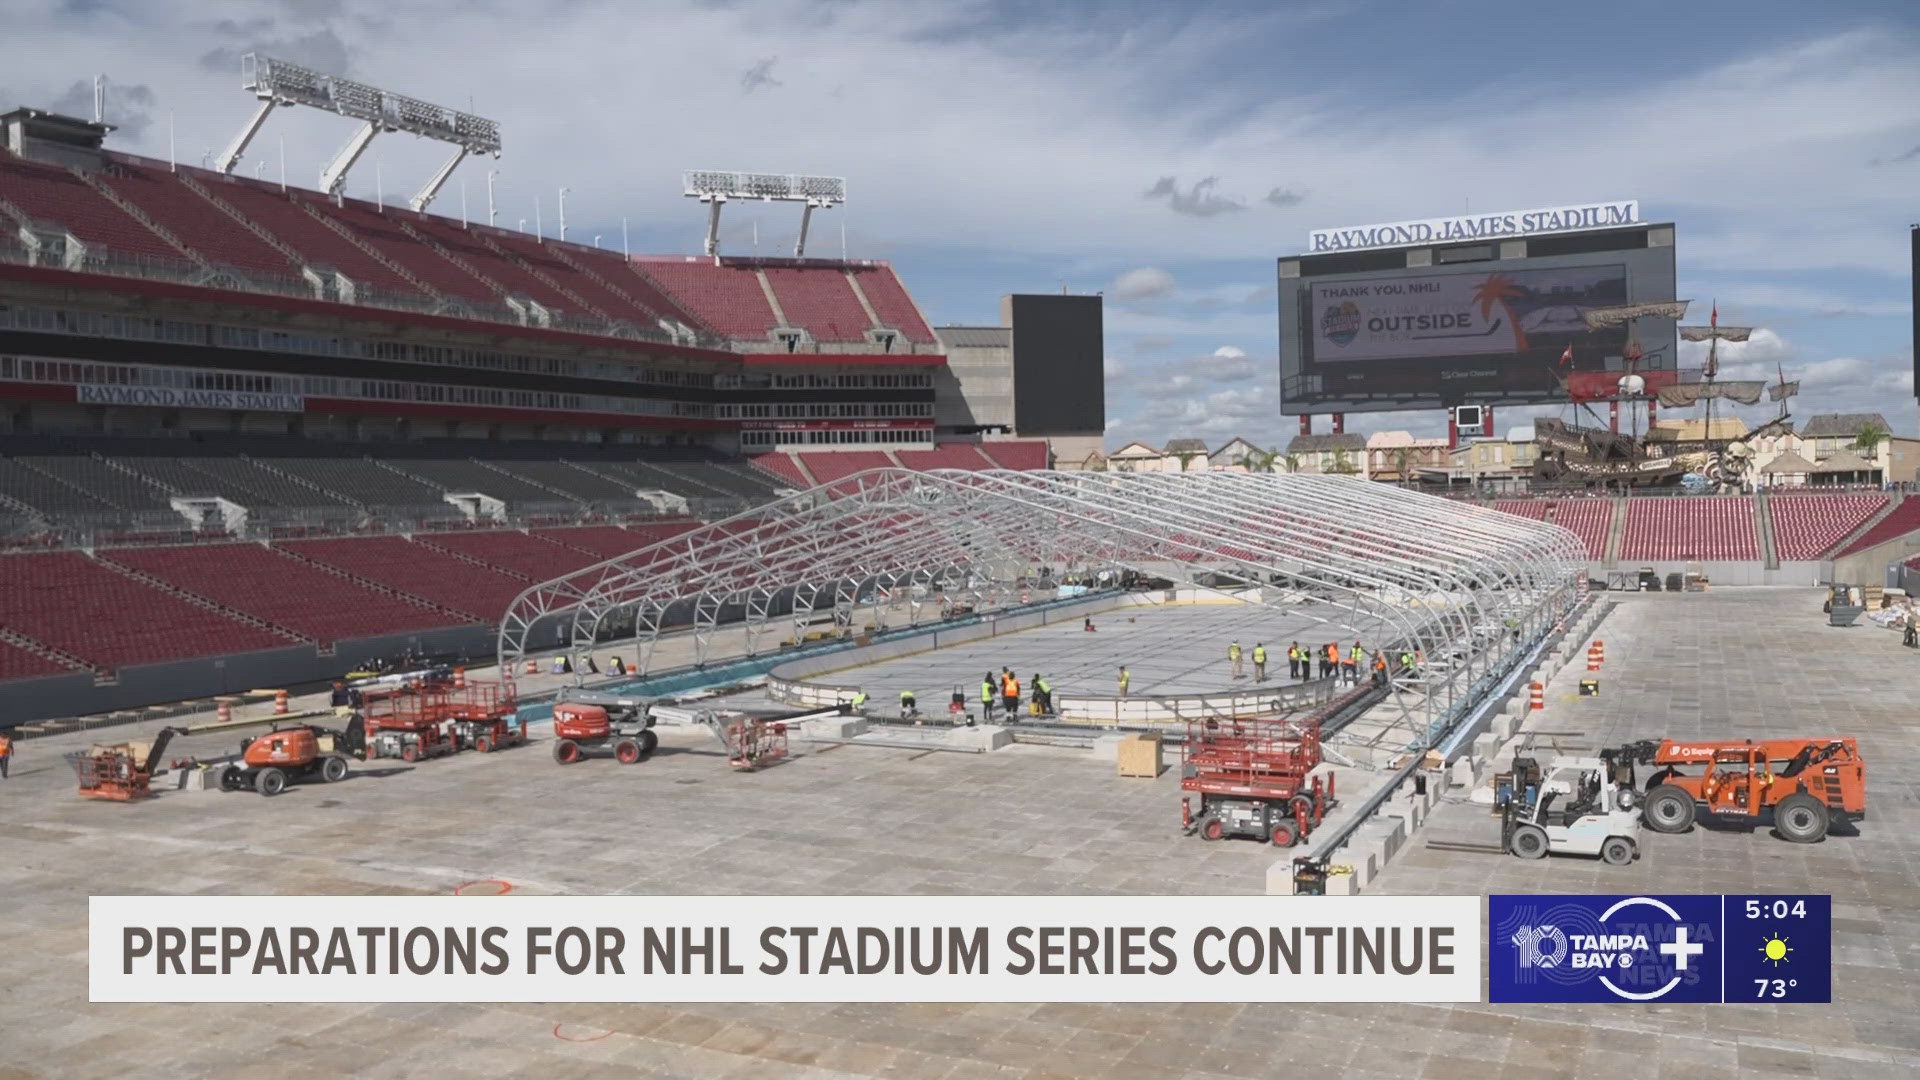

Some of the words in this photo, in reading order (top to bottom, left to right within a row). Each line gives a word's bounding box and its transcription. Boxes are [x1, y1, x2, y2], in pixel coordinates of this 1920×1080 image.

[1313, 223, 1432, 250] RAYMOND
[1436, 215, 1515, 240] JAMES
[1521, 204, 1633, 233] STADIUM
[1320, 286, 1369, 298] THANK
[1409, 282, 1440, 294] NHL!
[1368, 313, 1472, 332] OUTSIDE
[80, 386, 175, 405] RAYMOND
[178, 391, 233, 408] JAMES
[236, 395, 302, 410] STADIUM
